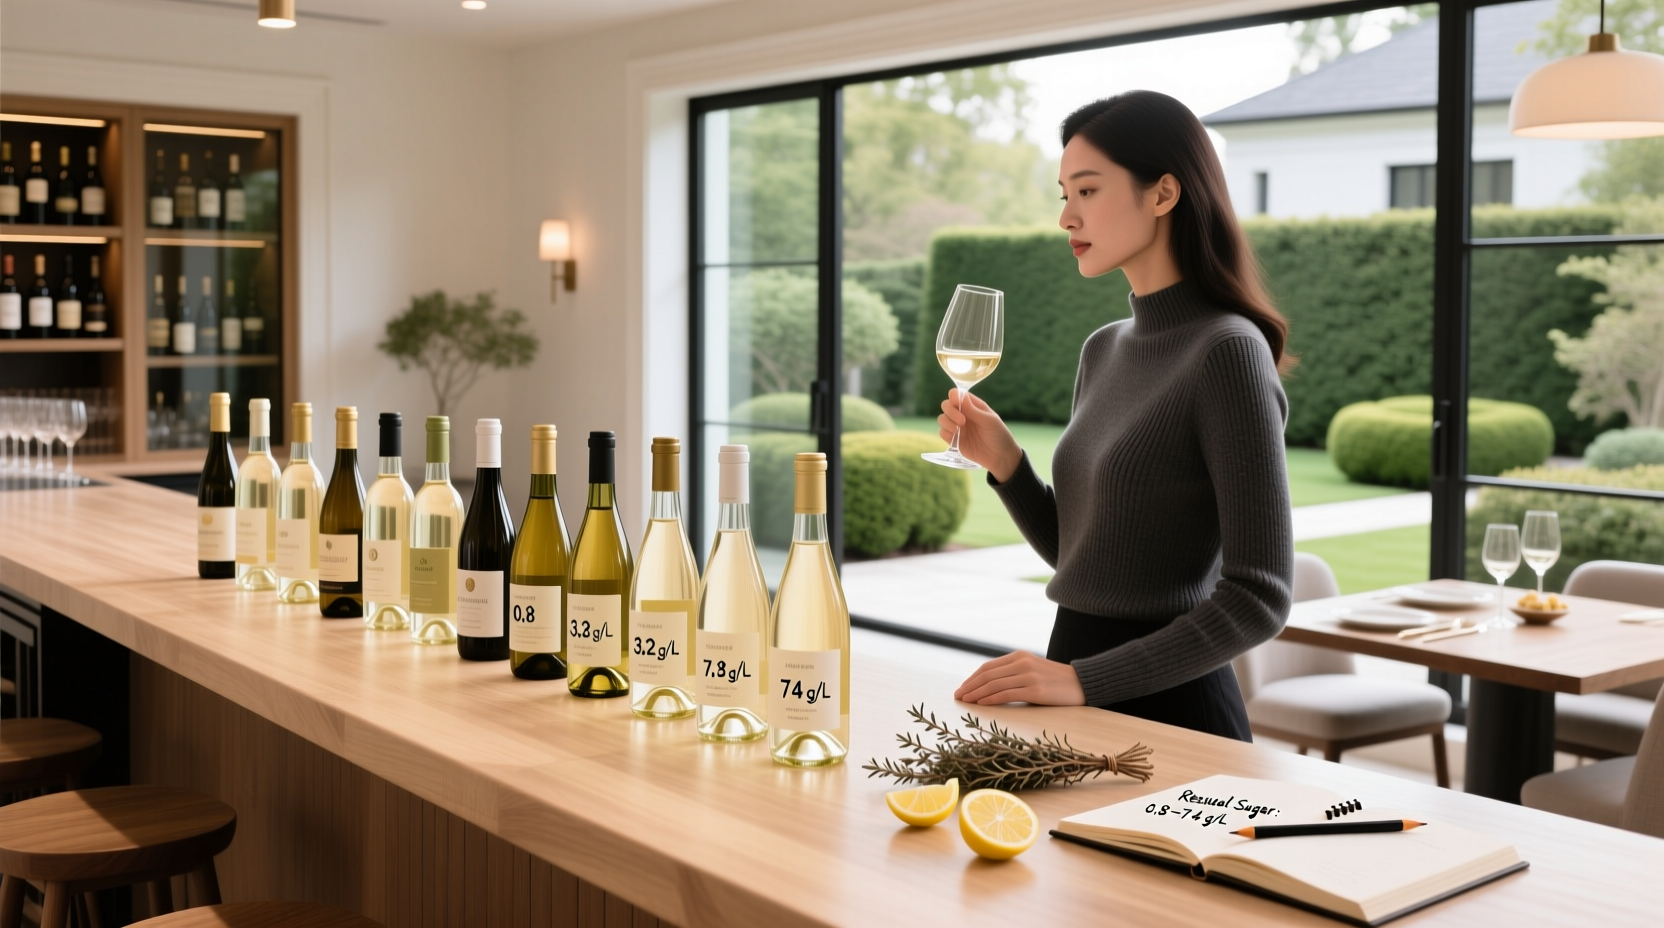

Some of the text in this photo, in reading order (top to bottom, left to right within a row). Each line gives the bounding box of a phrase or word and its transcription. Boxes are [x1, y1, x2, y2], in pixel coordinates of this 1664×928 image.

[513, 604, 536, 624] 0.8
[633, 636, 656, 656] 3.2
[780, 678, 804, 699] 74
